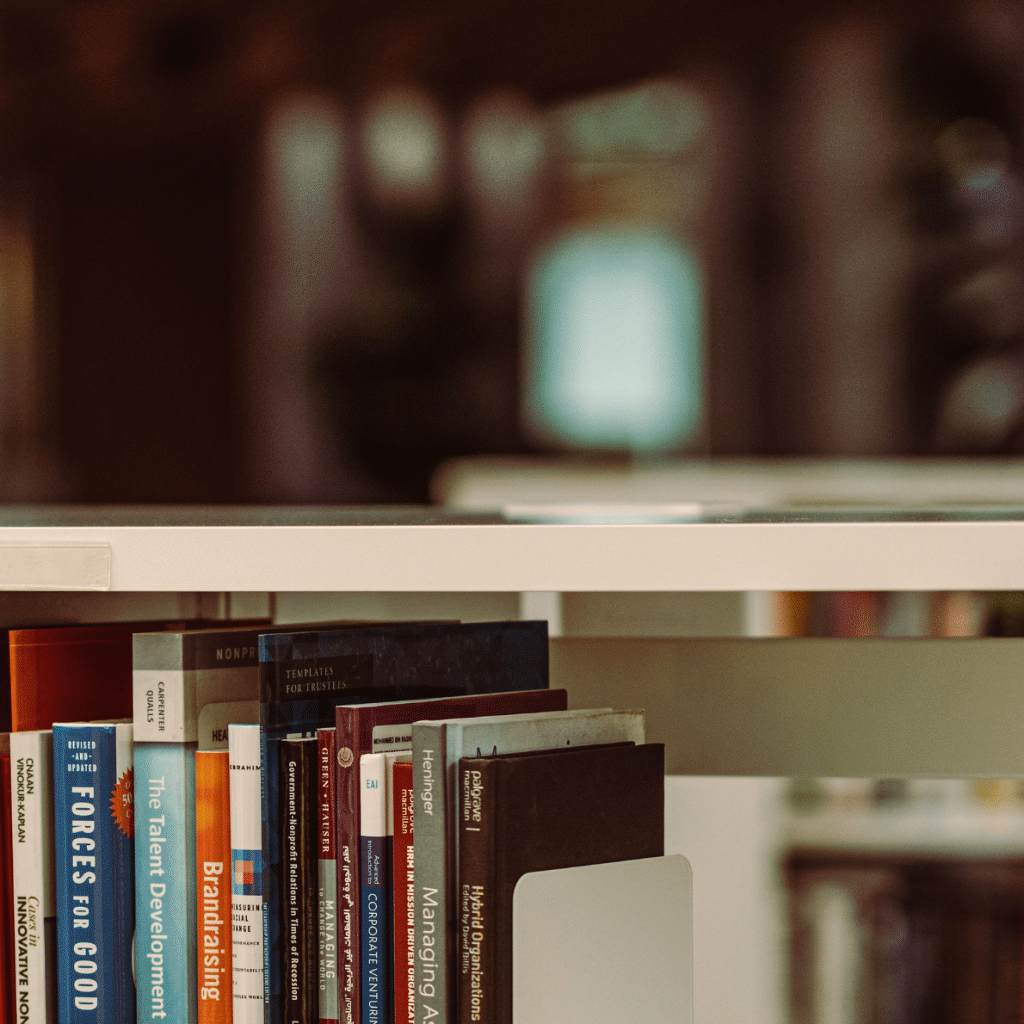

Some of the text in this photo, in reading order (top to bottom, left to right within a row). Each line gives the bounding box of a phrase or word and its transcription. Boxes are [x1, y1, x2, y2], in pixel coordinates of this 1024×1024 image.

[286, 666, 334, 679] TEMPLATES
[286, 680, 347, 694] FOR TRUSTEES
[146, 690, 154, 723] QUALLS
[26, 758, 34, 795] CNAAN
[68, 741, 96, 749] REVISED
[68, 764, 97, 772] UPDATED
[16, 758, 26, 843] VINOKUR-KAPLAN
[149, 776, 166, 809] The
[322, 747, 330, 853] GREEN HAUSER
[421, 749, 434, 816] Heninger
[464, 770, 472, 821] macmillan
[470, 770, 484, 822] palgrave
[149, 815, 167, 876] Talent
[72, 786, 98, 1010] FORCES FOR GOOD
[288, 760, 300, 1000] Government-Nonprofit Relations in Times of Recession
[470, 884, 484, 928] Hybrid
[17, 896, 30, 986] INNOVATIVE
[28, 896, 41, 947] Cases in
[147, 883, 168, 1018] Development
[201, 861, 226, 1001] Brandraising
[326, 900, 335, 979] MANAGING
[368, 893, 378, 964] CORPORATE
[418, 886, 438, 997] Managing
[470, 932, 484, 1021] Organizations
